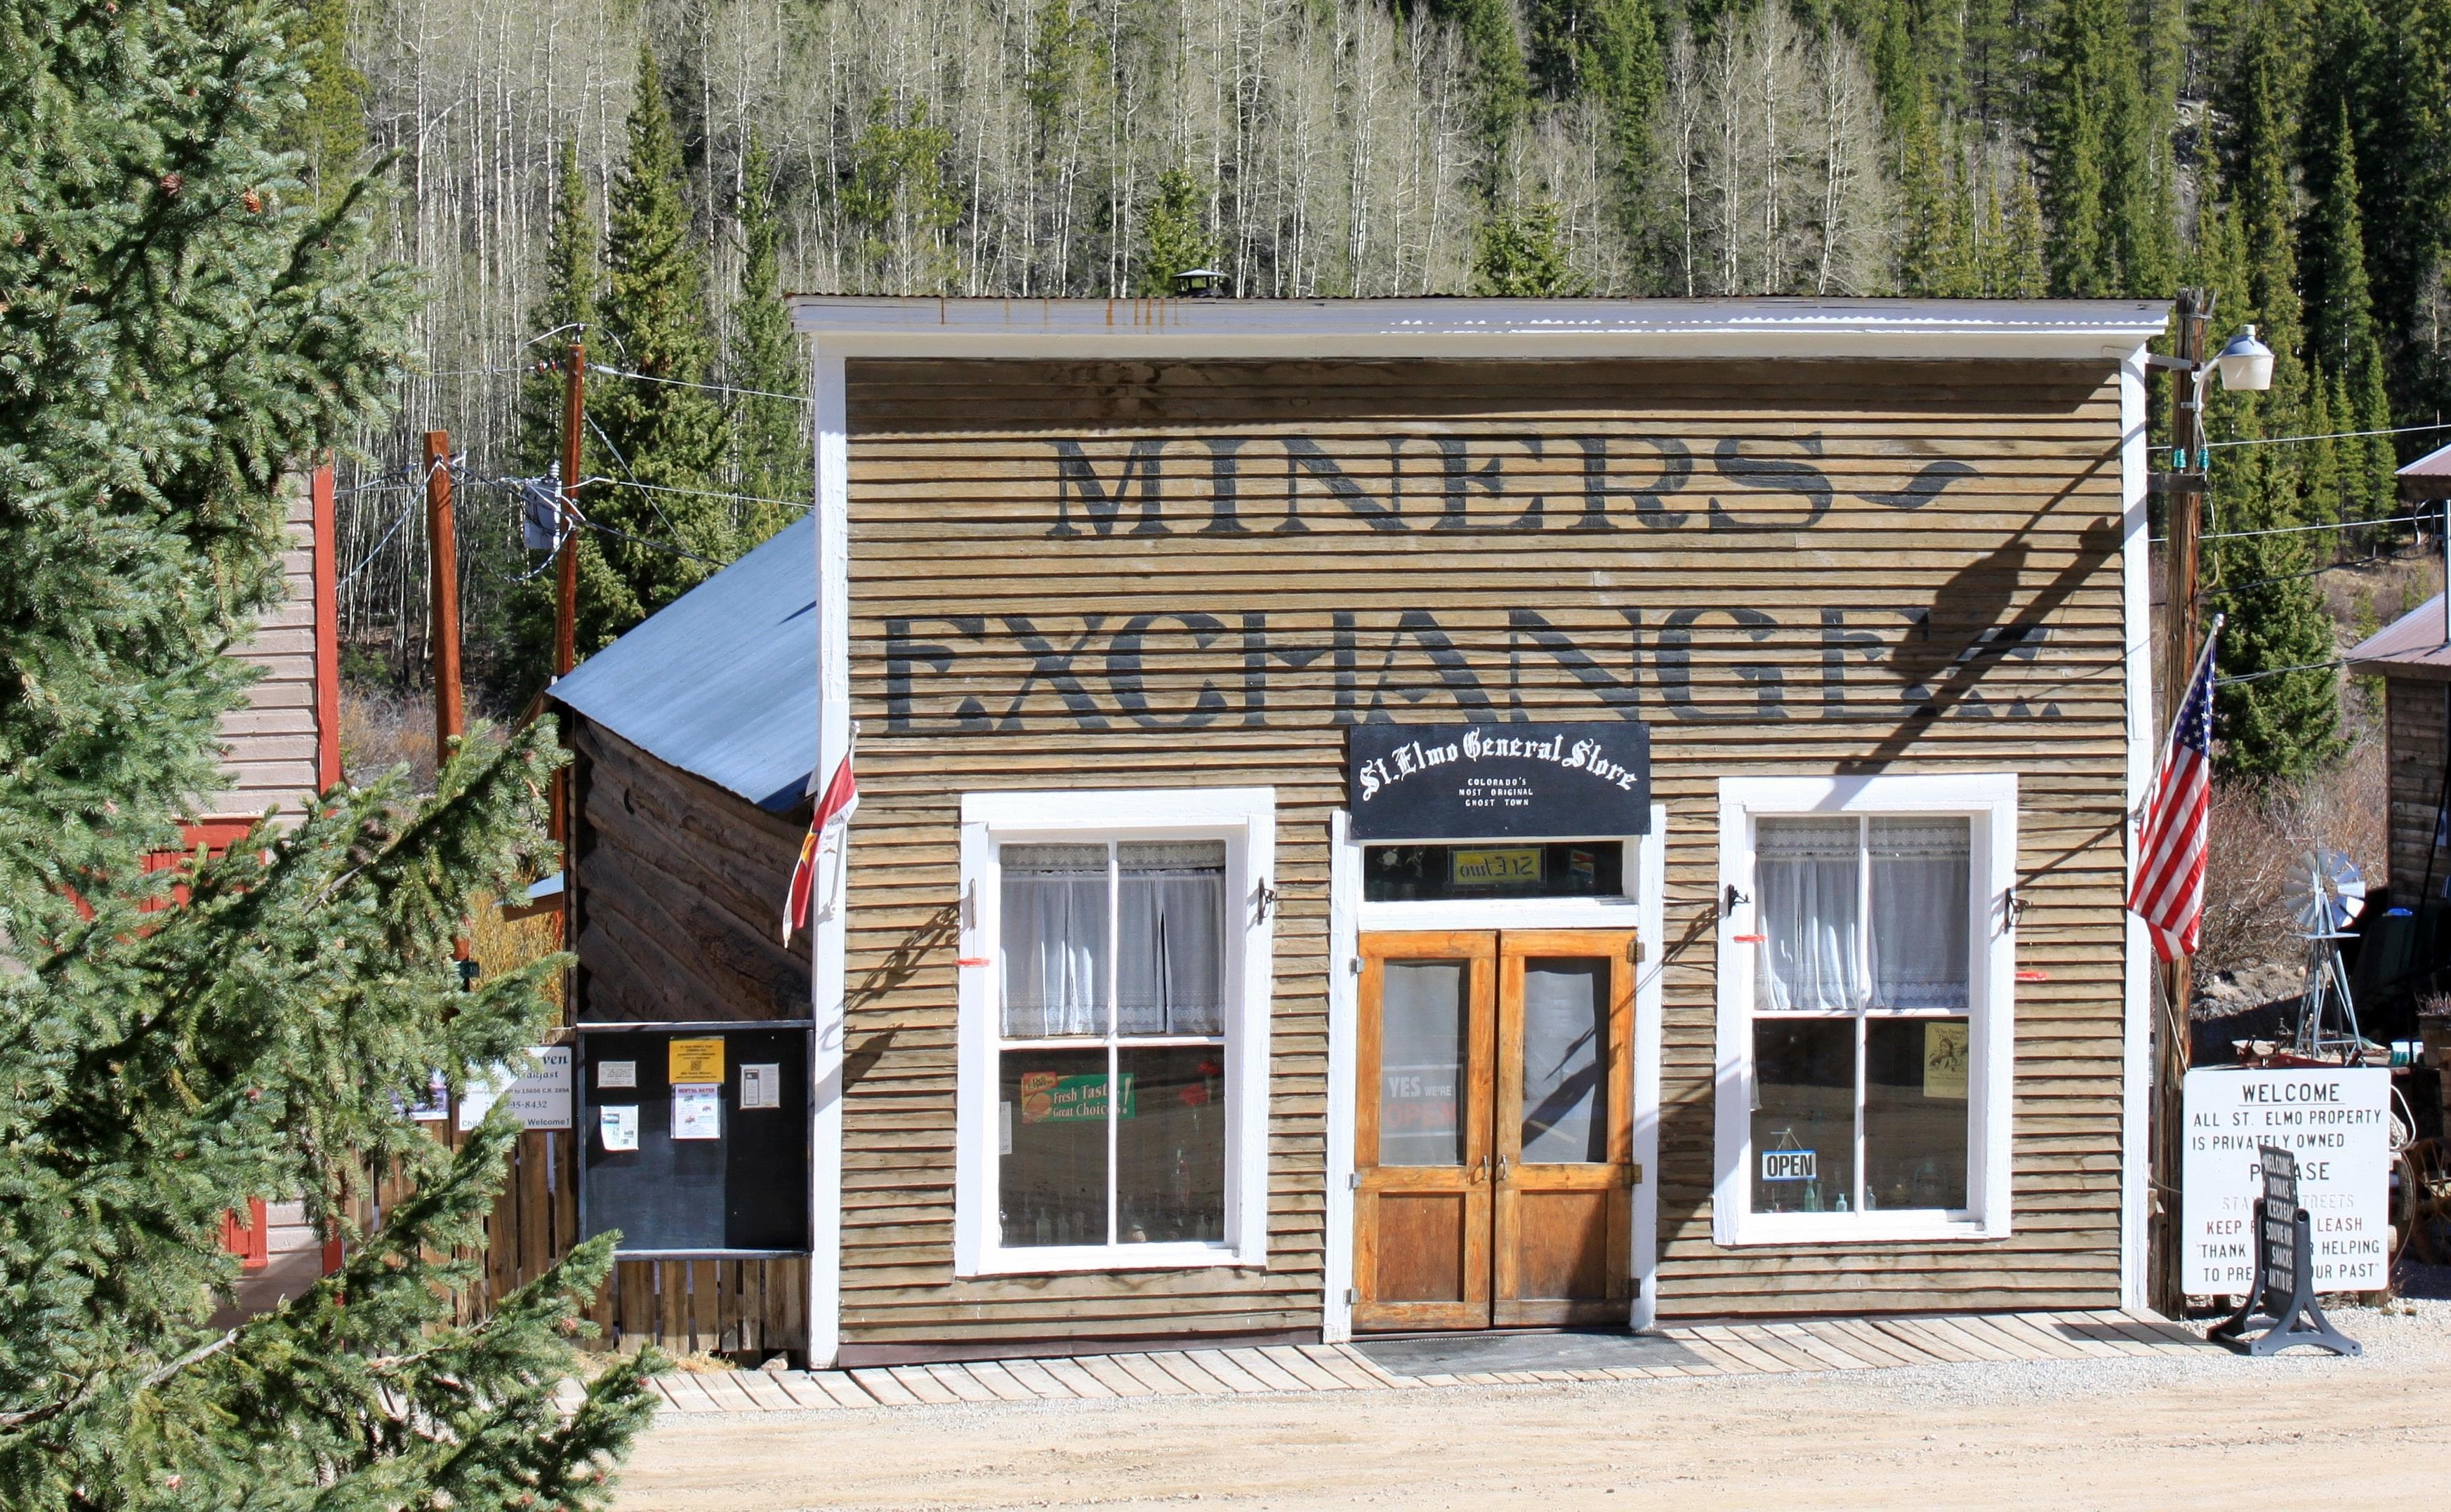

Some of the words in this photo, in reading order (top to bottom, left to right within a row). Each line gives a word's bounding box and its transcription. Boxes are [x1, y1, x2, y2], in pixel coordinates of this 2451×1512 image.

[1045, 431, 1833, 536] MINERS
[885, 608, 1939, 734] EXCHANGE
[1359, 757, 1400, 802] St.
[1392, 741, 1459, 781] Elmo
[1462, 727, 1562, 762] General
[1561, 738, 1637, 791] Store
[1467, 776, 1526, 786] COLORADO'S
[1505, 798, 1528, 807] TOWN
[1054, 1086, 1077, 1104] Fresh
[1388, 1076, 1421, 1098] YES
[1424, 1085, 1452, 1097] WE'RE
[2242, 1083, 2340, 1103] WELCOME
[1053, 1107, 1073, 1118] Great
[1381, 1100, 1458, 1129] OPEN
[2193, 1113, 2220, 1127] ALL
[2266, 1111, 2303, 1126] ELMO
[2309, 1109, 2381, 1125] PROPERTY
[2193, 1136, 2205, 1150] IS
[2297, 1133, 2345, 1148] OWNED
[1766, 1155, 1813, 1177] OPEN
[2249, 1162, 2330, 1181] PASE
[2207, 1220, 2242, 1235] KEEP
[2317, 1216, 2363, 1233] LEASH
[2322, 1240, 2380, 1256] HELPING
[2204, 1267, 2220, 1282] TO
